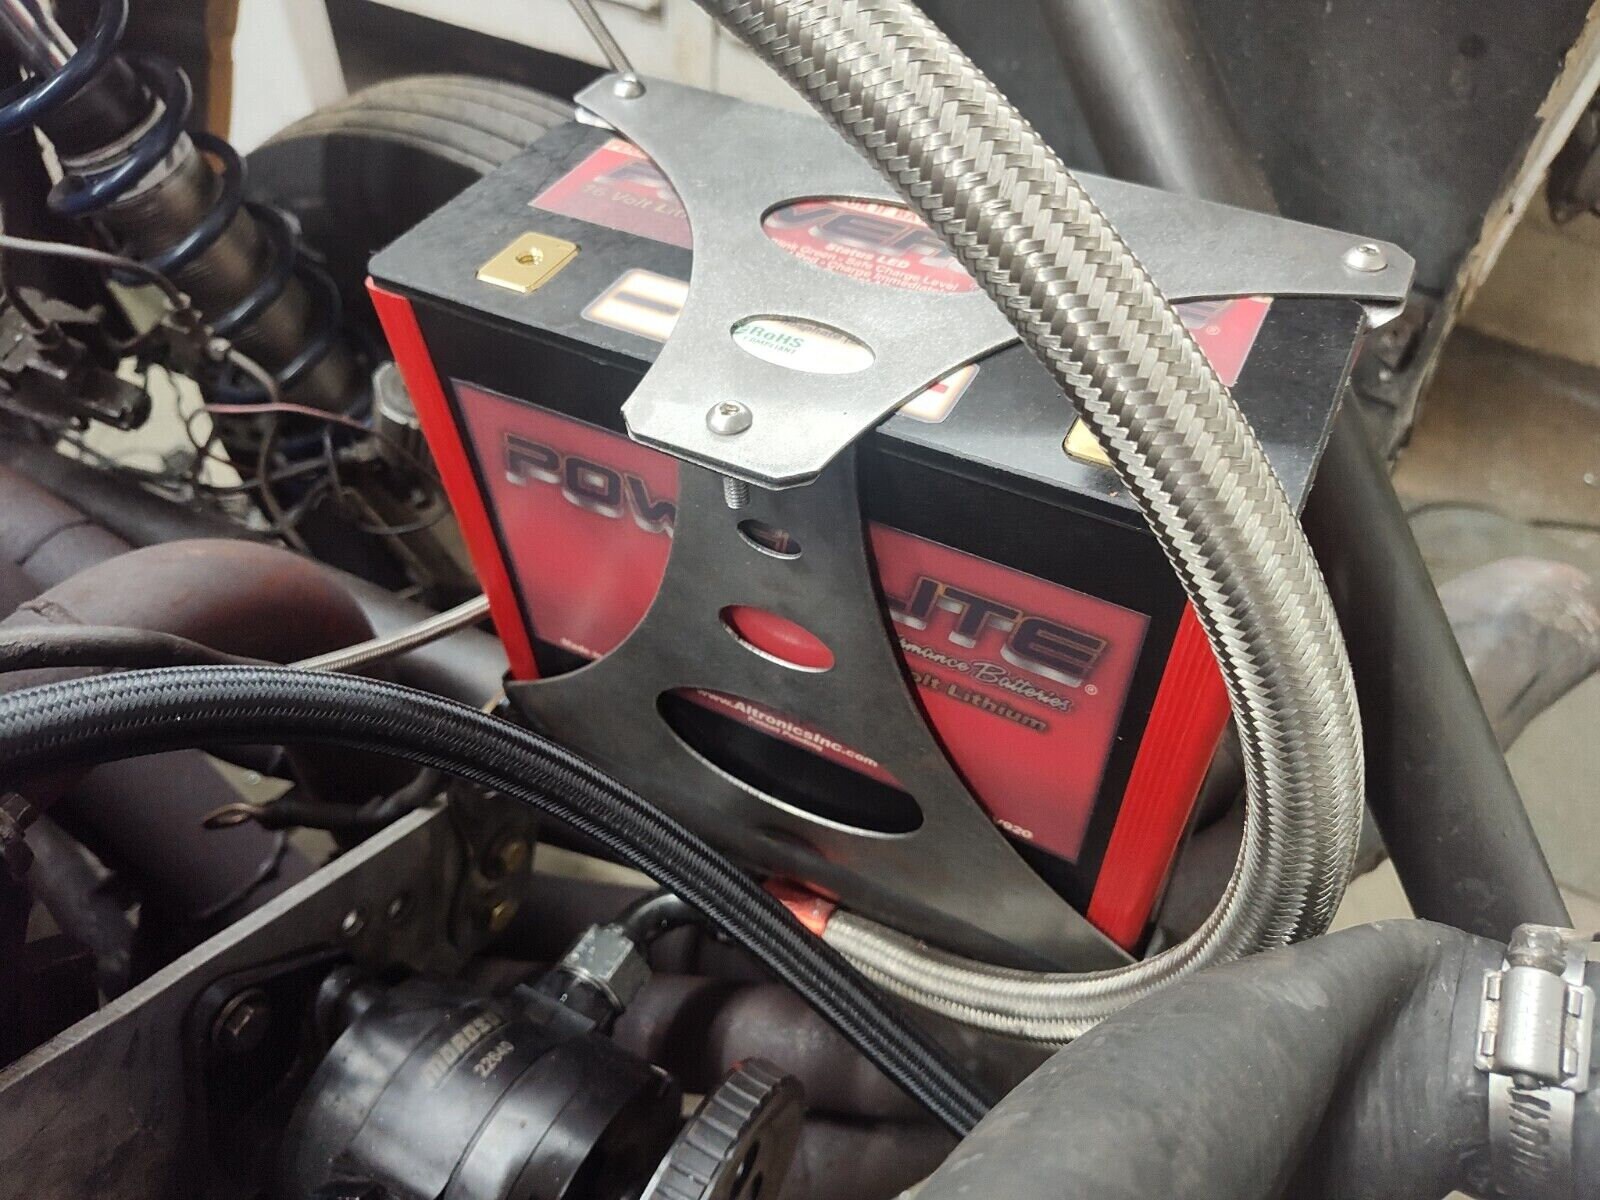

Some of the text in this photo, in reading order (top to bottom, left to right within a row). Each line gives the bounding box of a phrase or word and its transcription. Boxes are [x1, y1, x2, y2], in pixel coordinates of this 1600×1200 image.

[612, 191, 652, 209] Volt
[825, 243, 912, 271] Status LED
[875, 264, 922, 284] Charge
[922, 275, 965, 292] Level
[749, 325, 805, 349] RoHS
[970, 660, 1074, 711] Batteries
[947, 681, 1048, 732] Lithium
